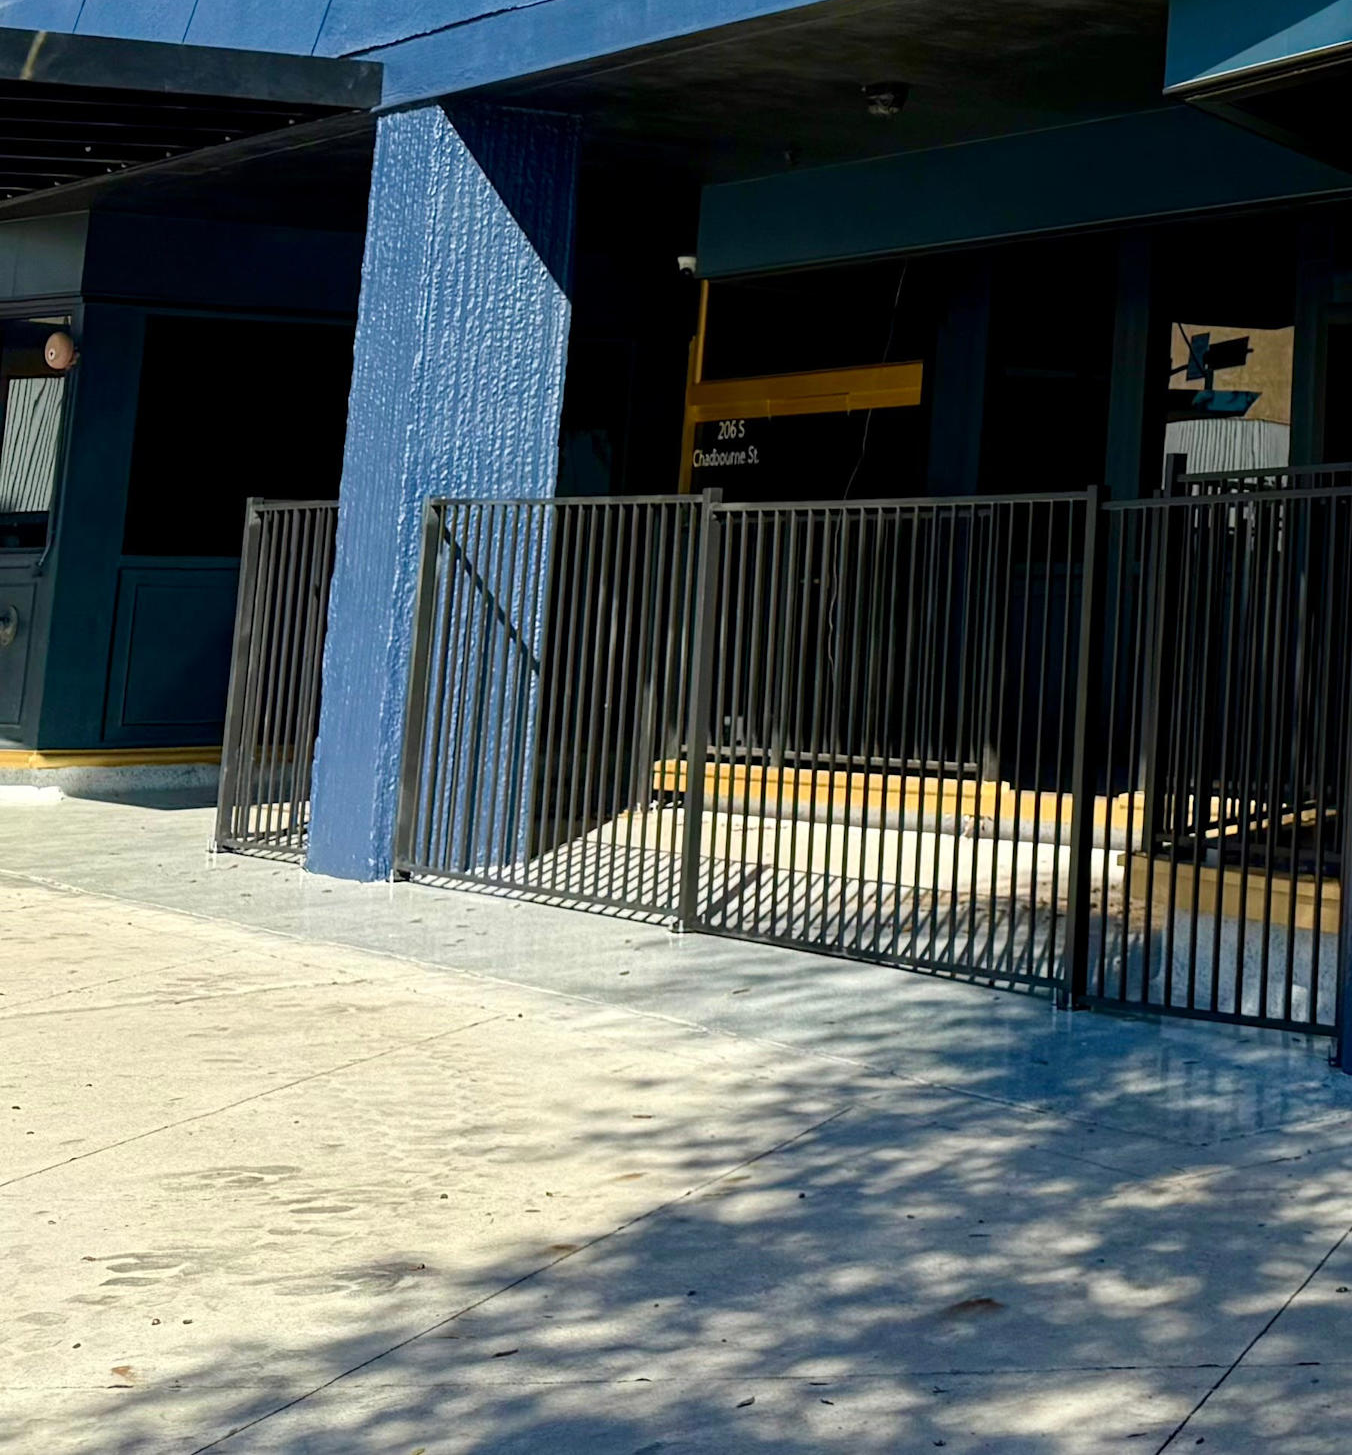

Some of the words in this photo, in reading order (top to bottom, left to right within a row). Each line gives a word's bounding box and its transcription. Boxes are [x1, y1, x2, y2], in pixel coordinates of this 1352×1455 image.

[717, 421, 737, 440] 206
[738, 420, 746, 439] S
[693, 448, 746, 468] Chadbourne
